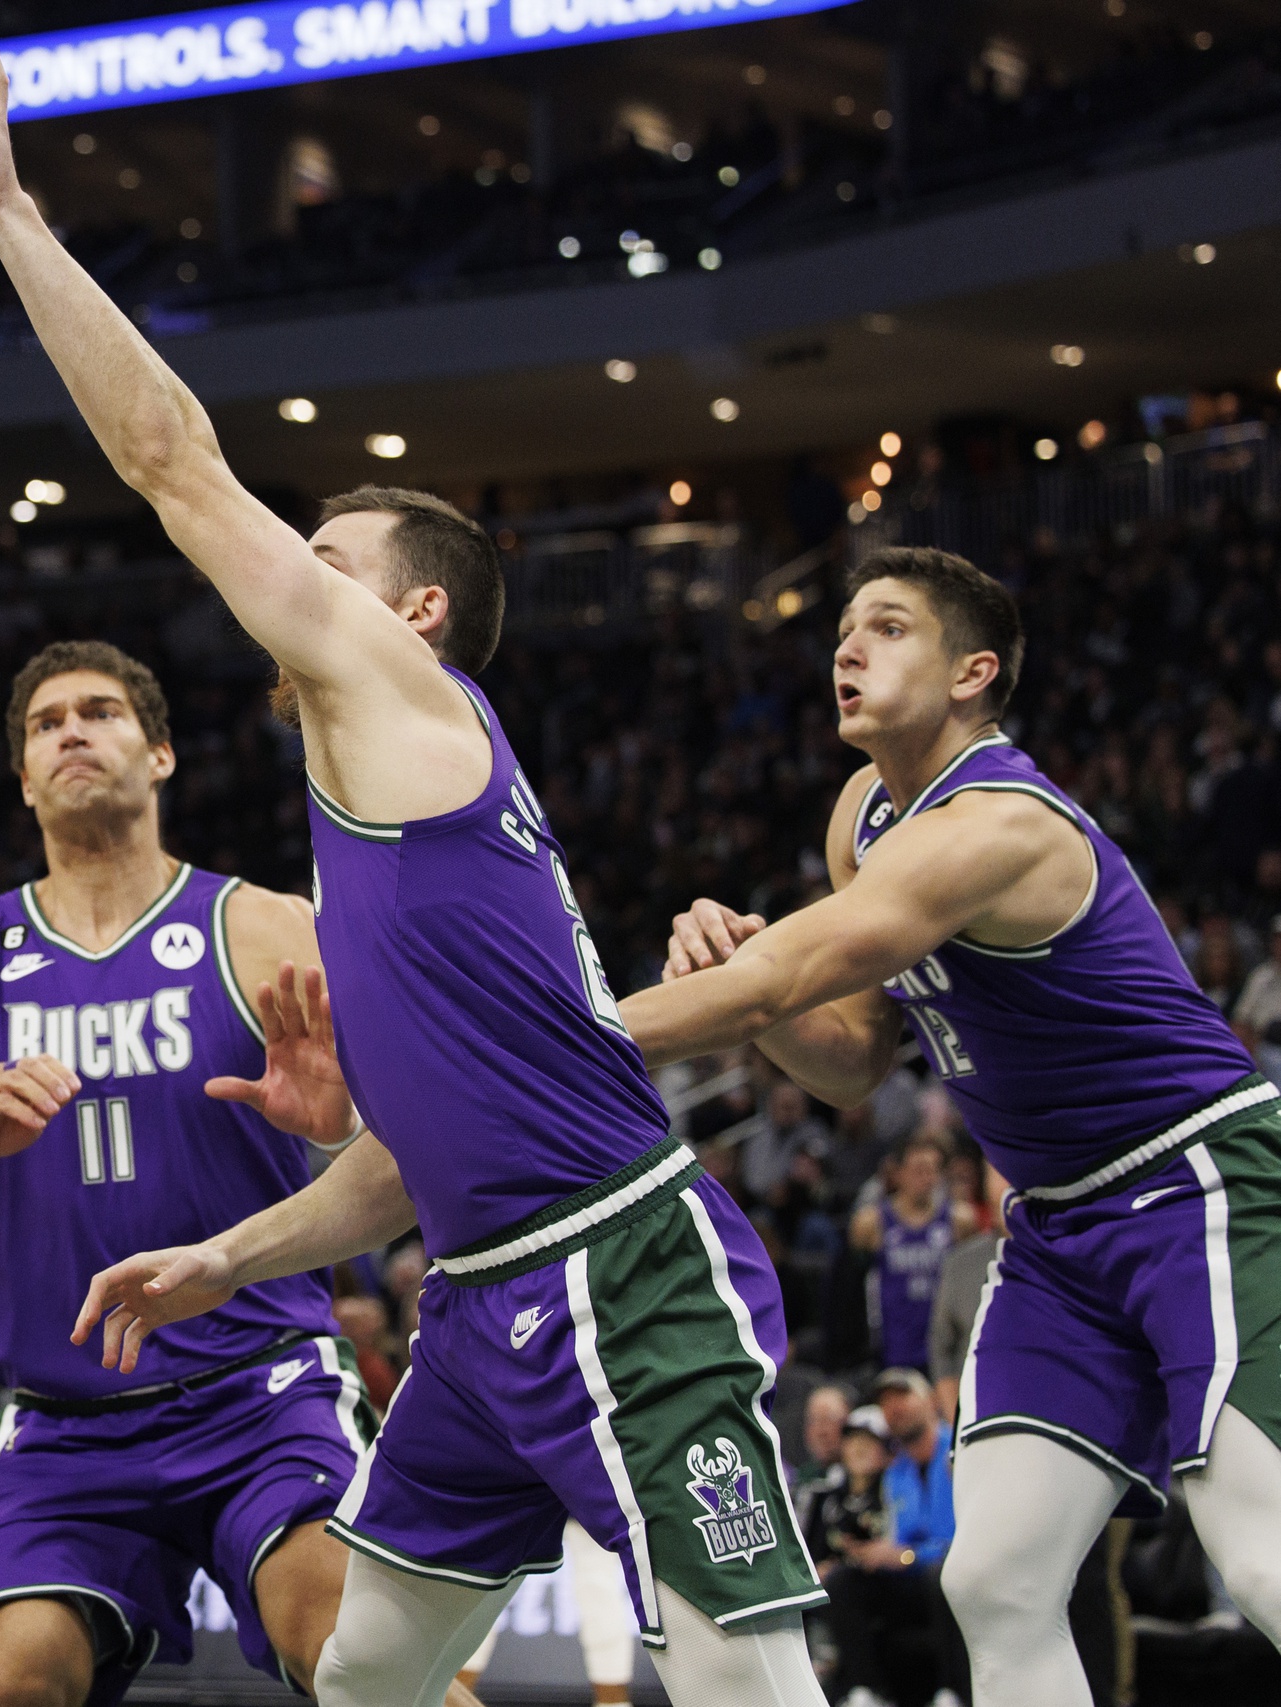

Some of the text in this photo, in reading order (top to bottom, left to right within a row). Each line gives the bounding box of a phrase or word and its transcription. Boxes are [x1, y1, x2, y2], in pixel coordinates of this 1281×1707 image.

[869, 801, 893, 829] 6
[3, 925, 25, 950] 6
[3, 985, 194, 1080] BUCKS
[902, 1001, 977, 1081] 12
[76, 1096, 136, 1186] 11
[514, 1305, 541, 1334] NIKE
[706, 1508, 771, 1555] BUCKS
[718, 1507, 753, 1520] MILWAUKEE
